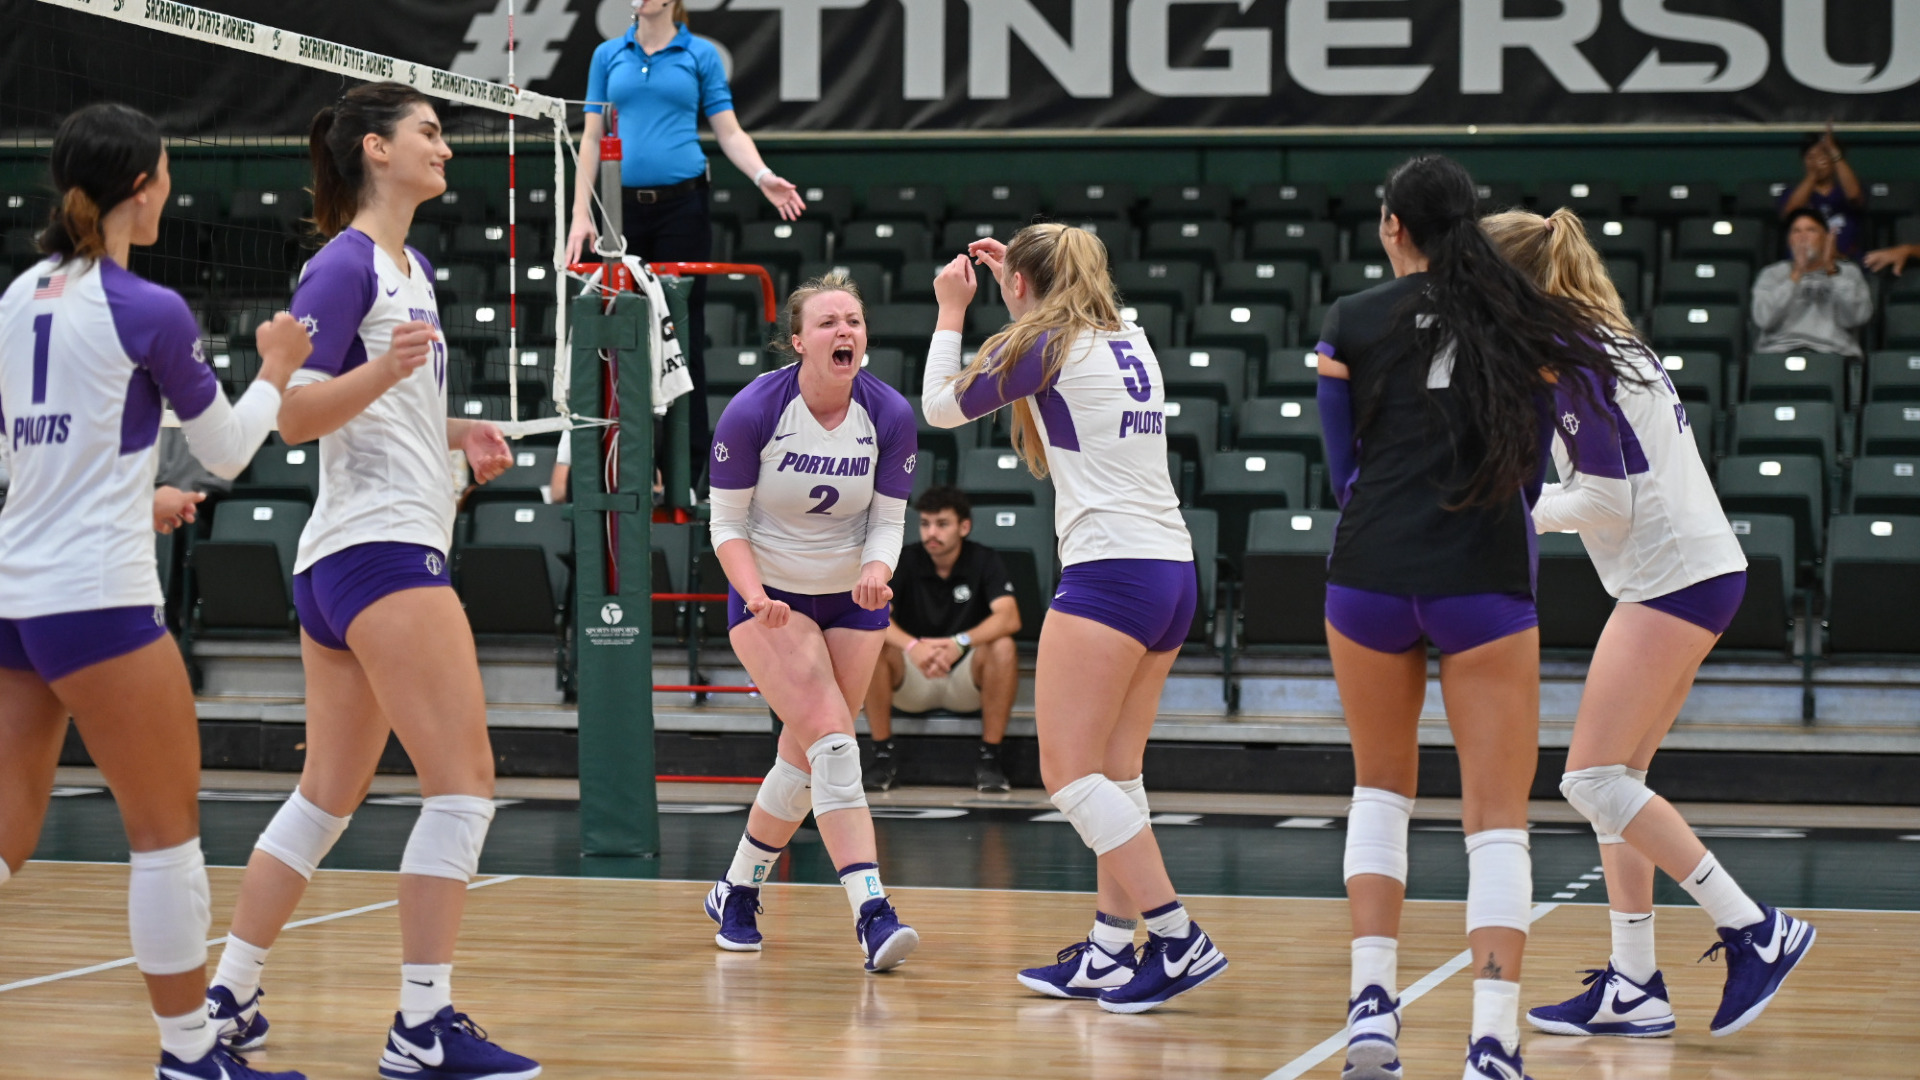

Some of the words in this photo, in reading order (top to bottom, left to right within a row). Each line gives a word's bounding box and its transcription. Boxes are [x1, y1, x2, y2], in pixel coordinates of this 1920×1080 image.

[145, 0, 196, 30] SACRAMENTO
[197, 10, 221, 35] STATE
[222, 16, 255, 43] HORNETS
[299, 36, 342, 66] SACRAMENTO
[343, 47, 364, 72] STATE
[365, 54, 394, 78] HORNETS
[448, 0, 1920, 107] #TINGERSU
[431, 70, 469, 95] SACRAMENTO
[469, 79, 488, 99] STATE
[489, 85, 515, 107] HORNETS
[32, 313, 53, 405] 1
[1107, 340, 1151, 403] 5
[13, 414, 72, 452] PILOTS
[1119, 410, 1163, 439] PILOTS
[777, 451, 871, 477] PORTLAND
[805, 484, 840, 515] 2
